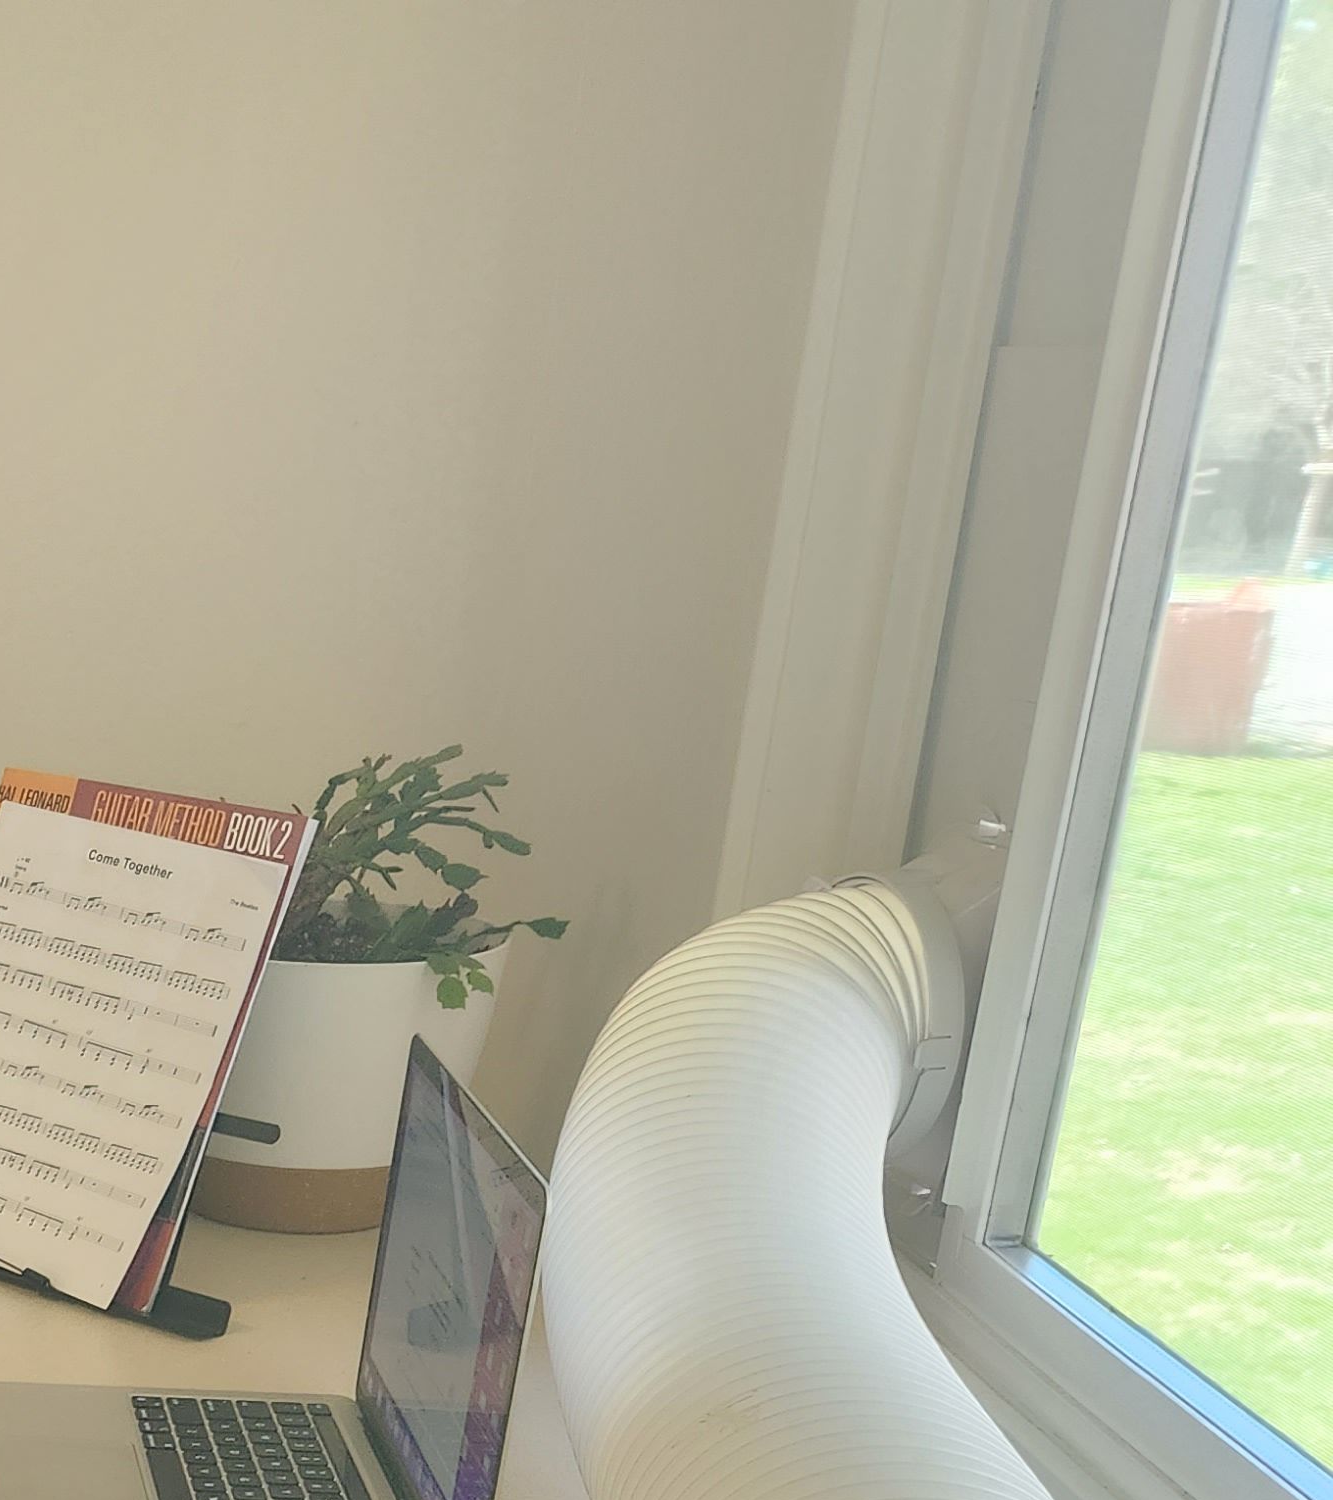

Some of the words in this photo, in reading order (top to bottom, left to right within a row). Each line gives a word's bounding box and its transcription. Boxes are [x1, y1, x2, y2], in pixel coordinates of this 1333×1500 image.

[19, 787, 71, 814] LEONARD
[92, 790, 150, 832] GUITAR
[150, 803, 226, 847] METHOD
[223, 812, 279, 856] BOOK
[88, 849, 120, 867] Come
[123, 857, 173, 880] Together
